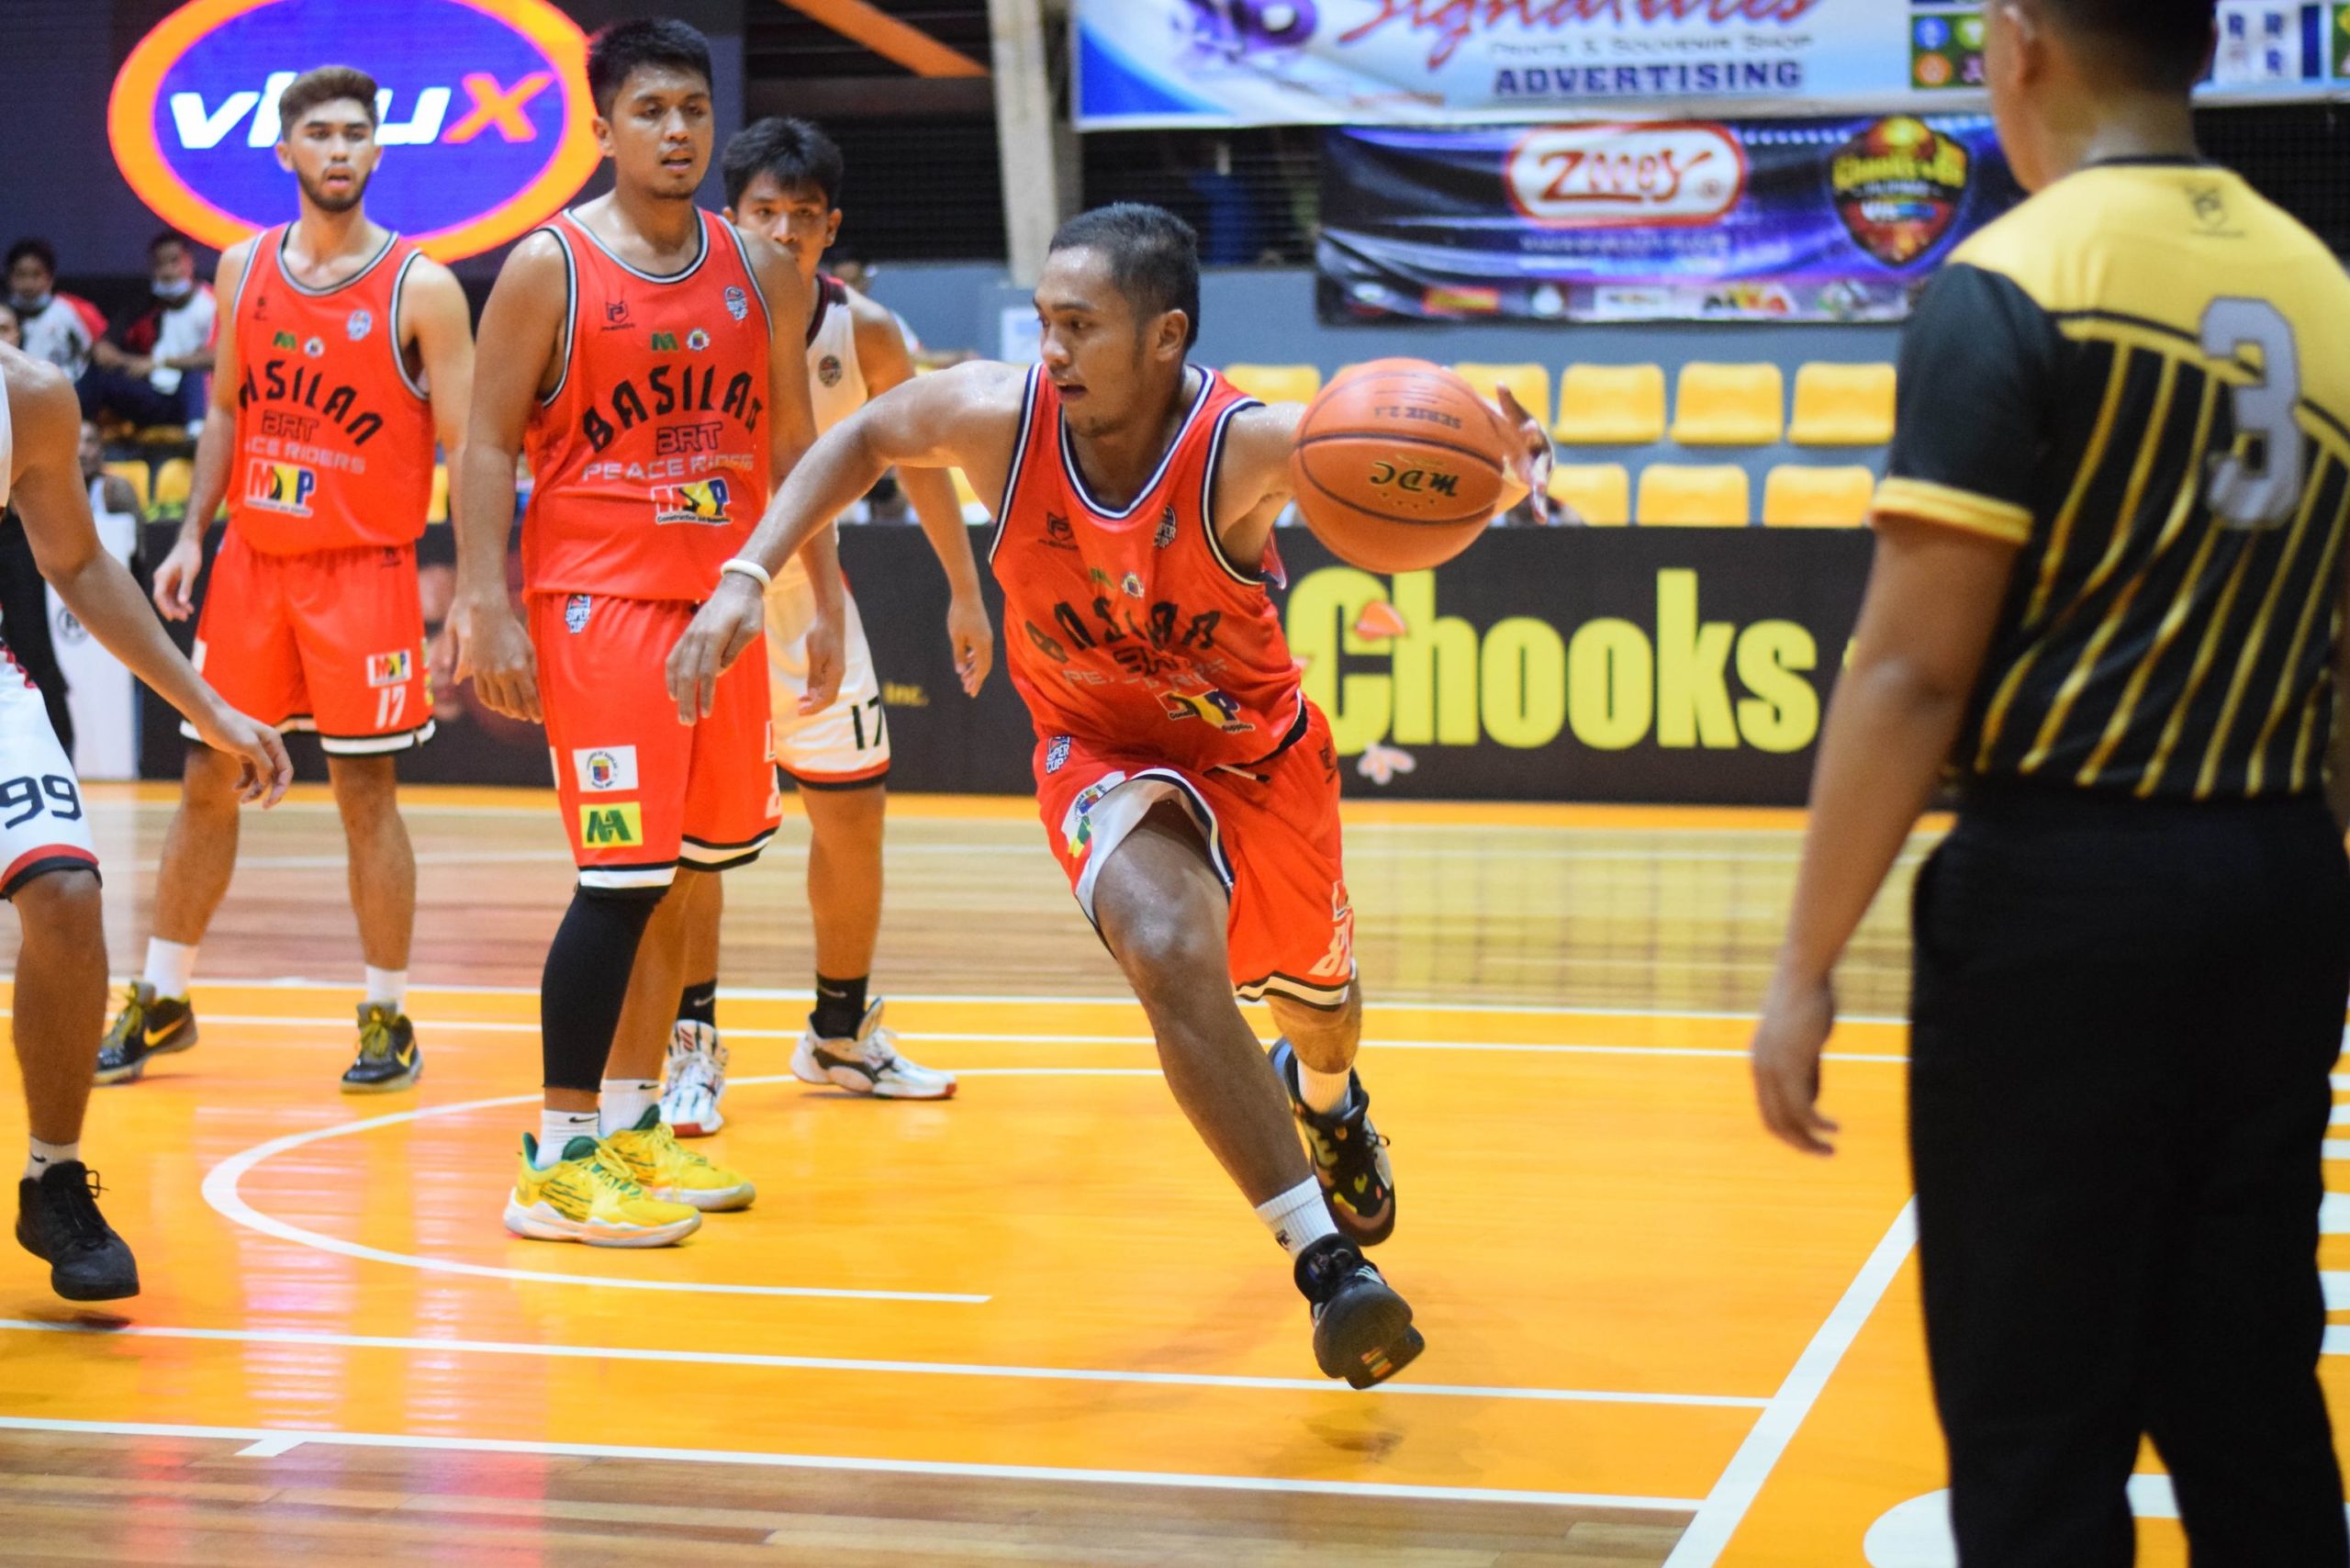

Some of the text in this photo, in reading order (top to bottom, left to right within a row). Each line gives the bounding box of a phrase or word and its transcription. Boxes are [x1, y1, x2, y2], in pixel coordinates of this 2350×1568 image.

[1494, 61, 1803, 95] ADVERTISING
[239, 359, 383, 447] ASILAN
[2199, 295, 2304, 530] 3
[656, 421, 723, 455] BRT
[582, 457, 685, 482] PEACE
[1370, 462, 1462, 497] MDC
[1287, 566, 1819, 755] Chooks
[375, 684, 407, 730] 17
[851, 695, 882, 751] 17
[0, 774, 83, 830] 99
